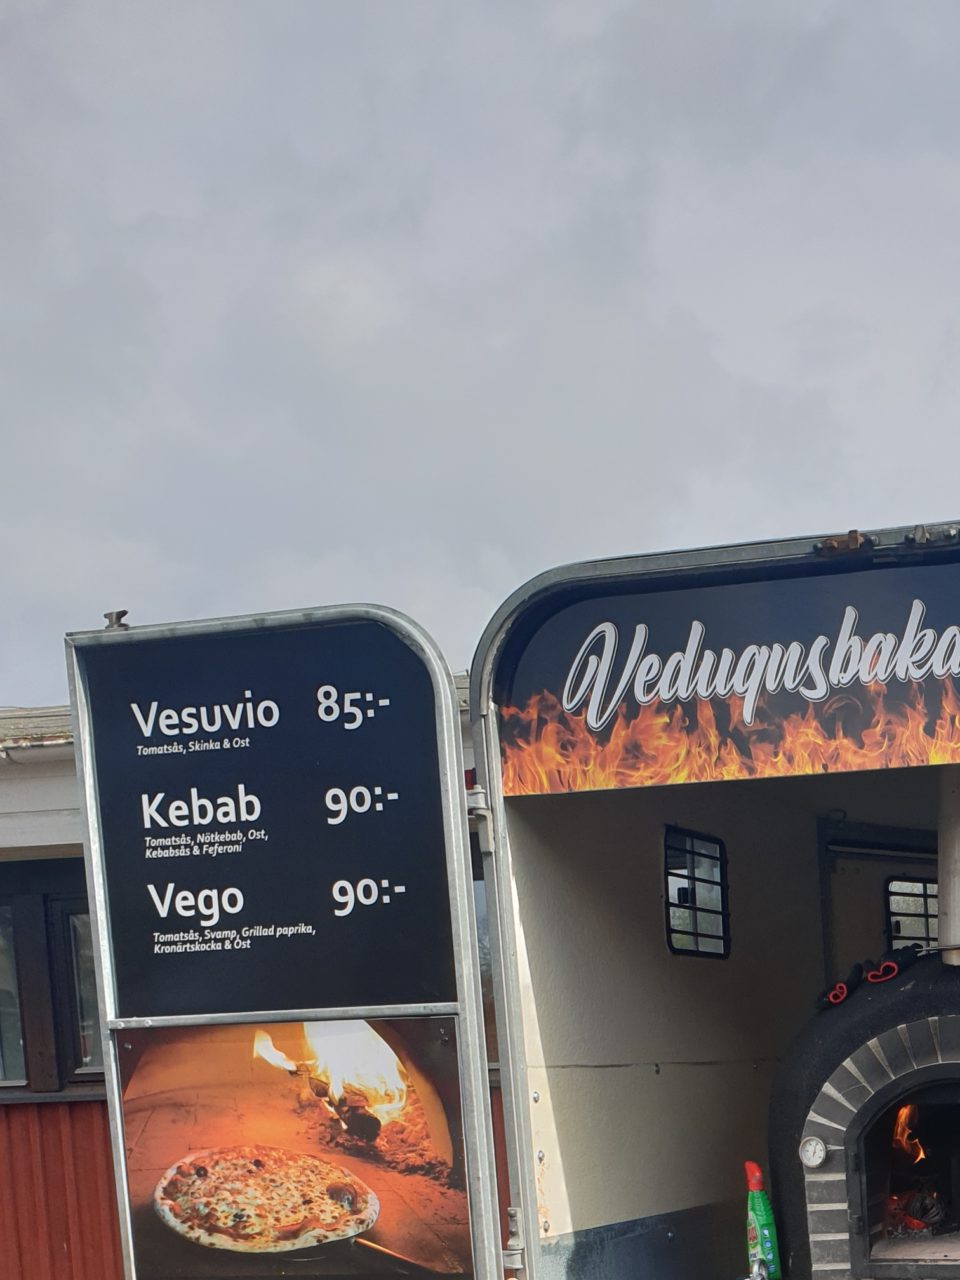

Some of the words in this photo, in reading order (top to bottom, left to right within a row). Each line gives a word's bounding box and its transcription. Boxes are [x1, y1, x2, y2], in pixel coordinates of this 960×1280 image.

[131, 690, 280, 737] Vesuvio
[316, 684, 391, 730] 85:-
[137, 744, 187, 755] Tomatsås,
[188, 739, 220, 752] Skinka
[223, 738, 230, 748] &
[233, 737, 250, 748] Ost
[141, 784, 262, 828] Kebab
[325, 785, 399, 825] 90:-
[145, 834, 195, 847] Tomatsås,
[197, 830, 246, 844] Nötkebab,
[248, 829, 268, 841] Ost,
[145, 845, 190, 858] Kebabsås
[193, 845, 200, 854] &
[202, 842, 242, 857] Feferoni
[147, 883, 244, 926] Vego
[332, 878, 406, 917] 90:-
[153, 929, 202, 942] Tomatsås,
[204, 928, 240, 941] Svamp,
[242, 925, 274, 937] Grillad
[276, 924, 316, 935] paprika,
[154, 940, 222, 954] Kronärtskocka
[224, 939, 232, 949] &
[234, 938, 251, 949] Ost
